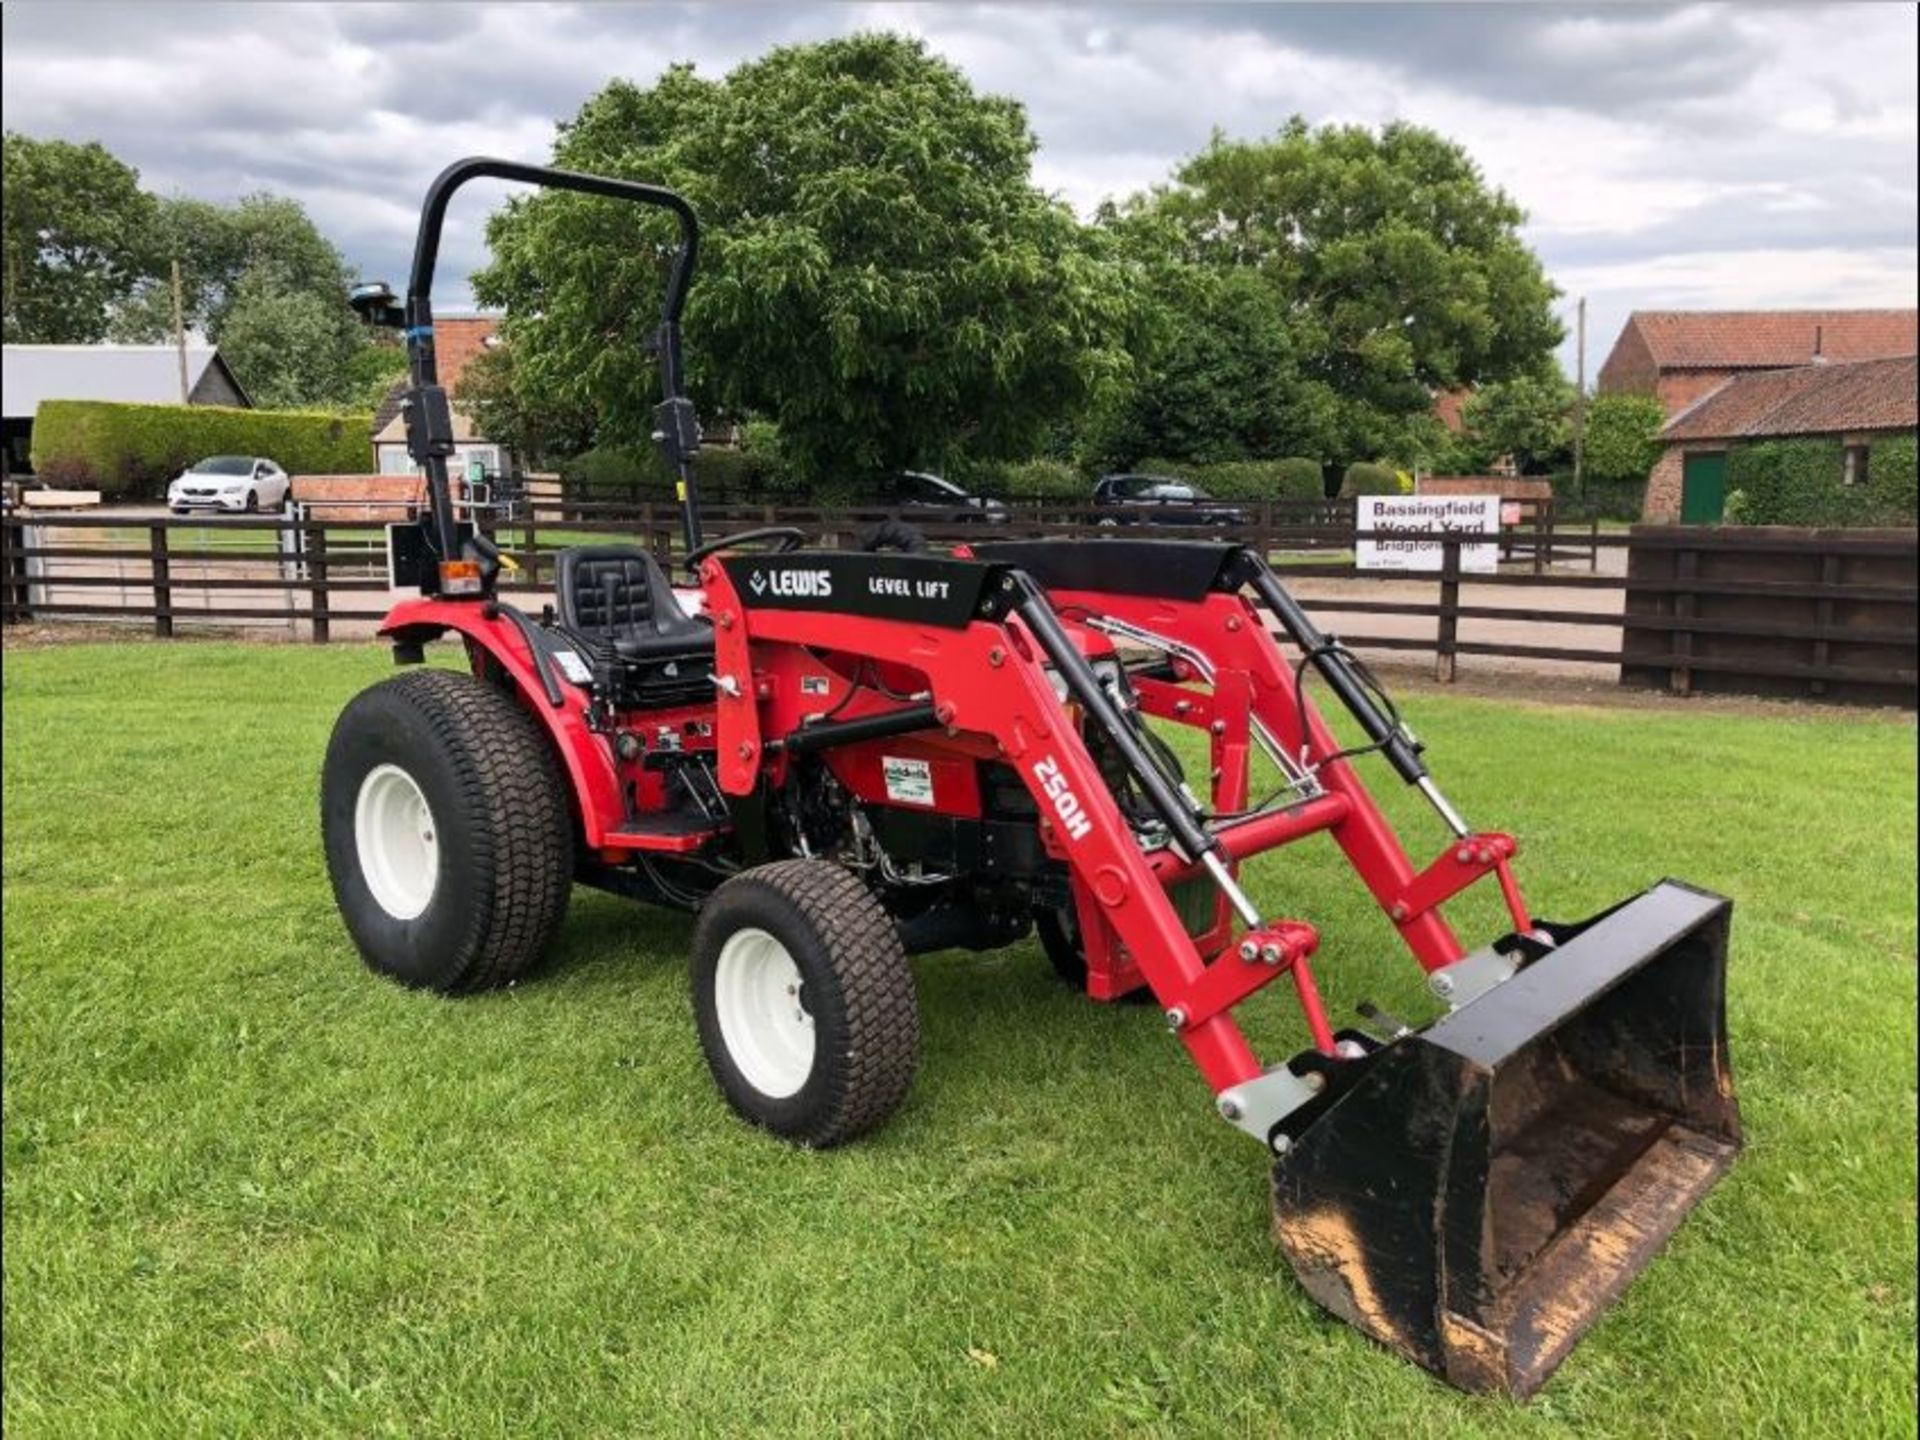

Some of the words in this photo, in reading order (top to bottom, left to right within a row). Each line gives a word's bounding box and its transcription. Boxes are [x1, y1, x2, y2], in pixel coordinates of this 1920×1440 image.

[1373, 502, 1485, 518] Bassingfield
[1373, 520, 1432, 534] Wood
[1440, 520, 1485, 534] Yard
[769, 570, 832, 597] LEWIS
[868, 577, 910, 597] LEVEL
[916, 580, 950, 599] LIFT
